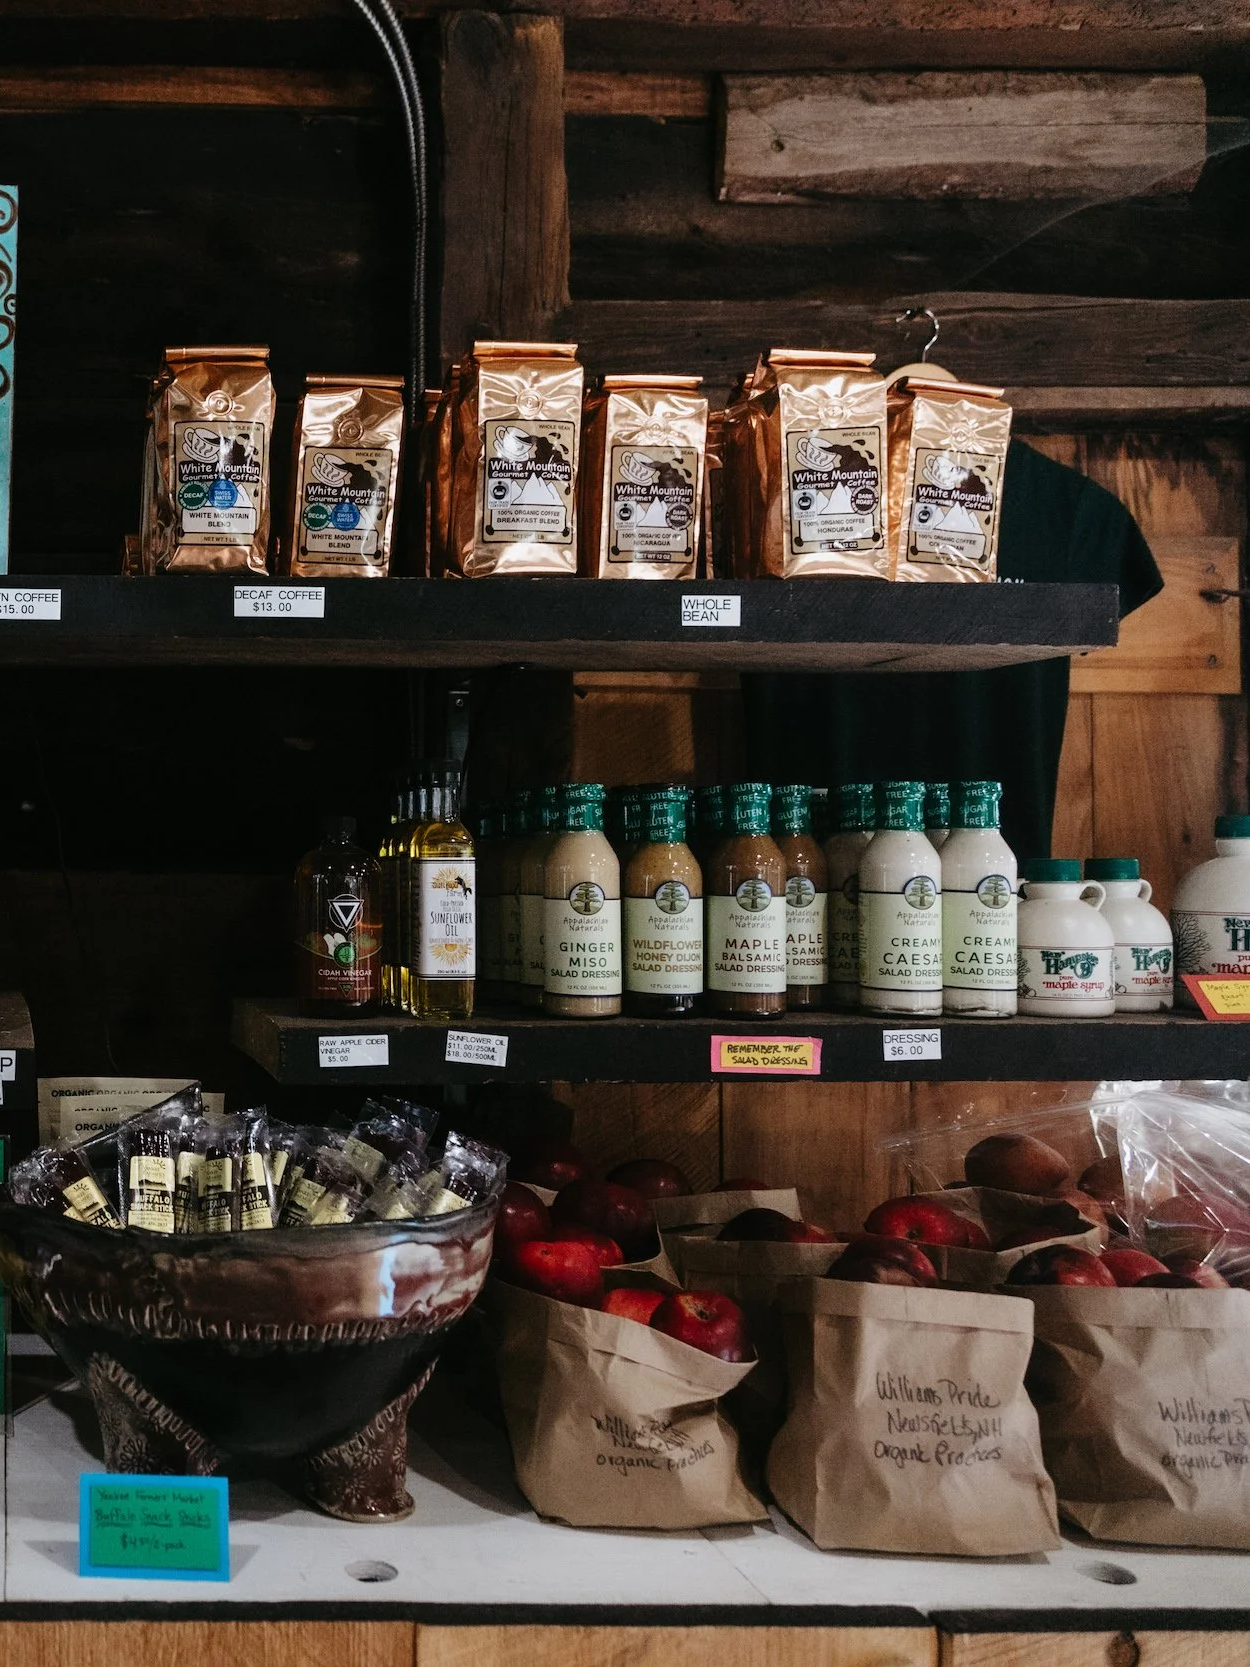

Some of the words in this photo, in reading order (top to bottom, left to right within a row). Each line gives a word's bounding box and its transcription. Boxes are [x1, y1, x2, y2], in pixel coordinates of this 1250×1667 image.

[180, 464, 211, 474] White
[216, 463, 259, 475] Mountain
[491, 461, 523, 471] White
[526, 461, 570, 473] Mountain
[794, 472, 828, 482] White
[831, 470, 877, 480] Mountain
[307, 485, 338, 495] White
[340, 487, 385, 499] Mountain
[616, 485, 647, 495] White
[649, 485, 692, 496] Mountain
[918, 487, 949, 498] White
[951, 491, 993, 504] Mountain
[817, 526, 853, 534] HONDURAS
[15, 593, 59, 602] COFFEE
[235, 589, 273, 600] DECAF
[279, 590, 323, 600] COFFEE
[253, 602, 292, 612] $13.00
[683, 599, 731, 610] WHOLE
[683, 611, 719, 622] BEAN
[430, 912, 473, 924] SUNFLOWER
[445, 924, 458, 937] OIL
[633, 939, 702, 950] WILDFLOWER
[725, 939, 779, 950] MAPLE
[963, 936, 1015, 946] CREAMY
[560, 942, 614, 952] GINGER
[569, 957, 607, 967] MISO
[636, 953, 673, 962] HONEY
[676, 953, 701, 962] DIJON
[722, 953, 781, 962] BALSAMIC
[632, 963, 662, 972] SALAD
[715, 963, 744, 972] SALAD
[746, 964, 785, 973] DRESSING
[551, 969, 579, 977] SALAD
[581, 970, 620, 978] DRESSING
[1042, 981, 1077, 991] maple
[448, 1034, 492, 1045] SUNFLOWER
[884, 1033, 938, 1044] DRESSING
[727, 1044, 782, 1053] REMEMBER
[784, 1044, 803, 1053] THE
[891, 1046, 923, 1055] $6.00
[732, 1056, 759, 1066] SALAD
[762, 1056, 808, 1066] DRESSING
[876, 1372, 942, 1405] Williams
[943, 1379, 1000, 1408] Pride
